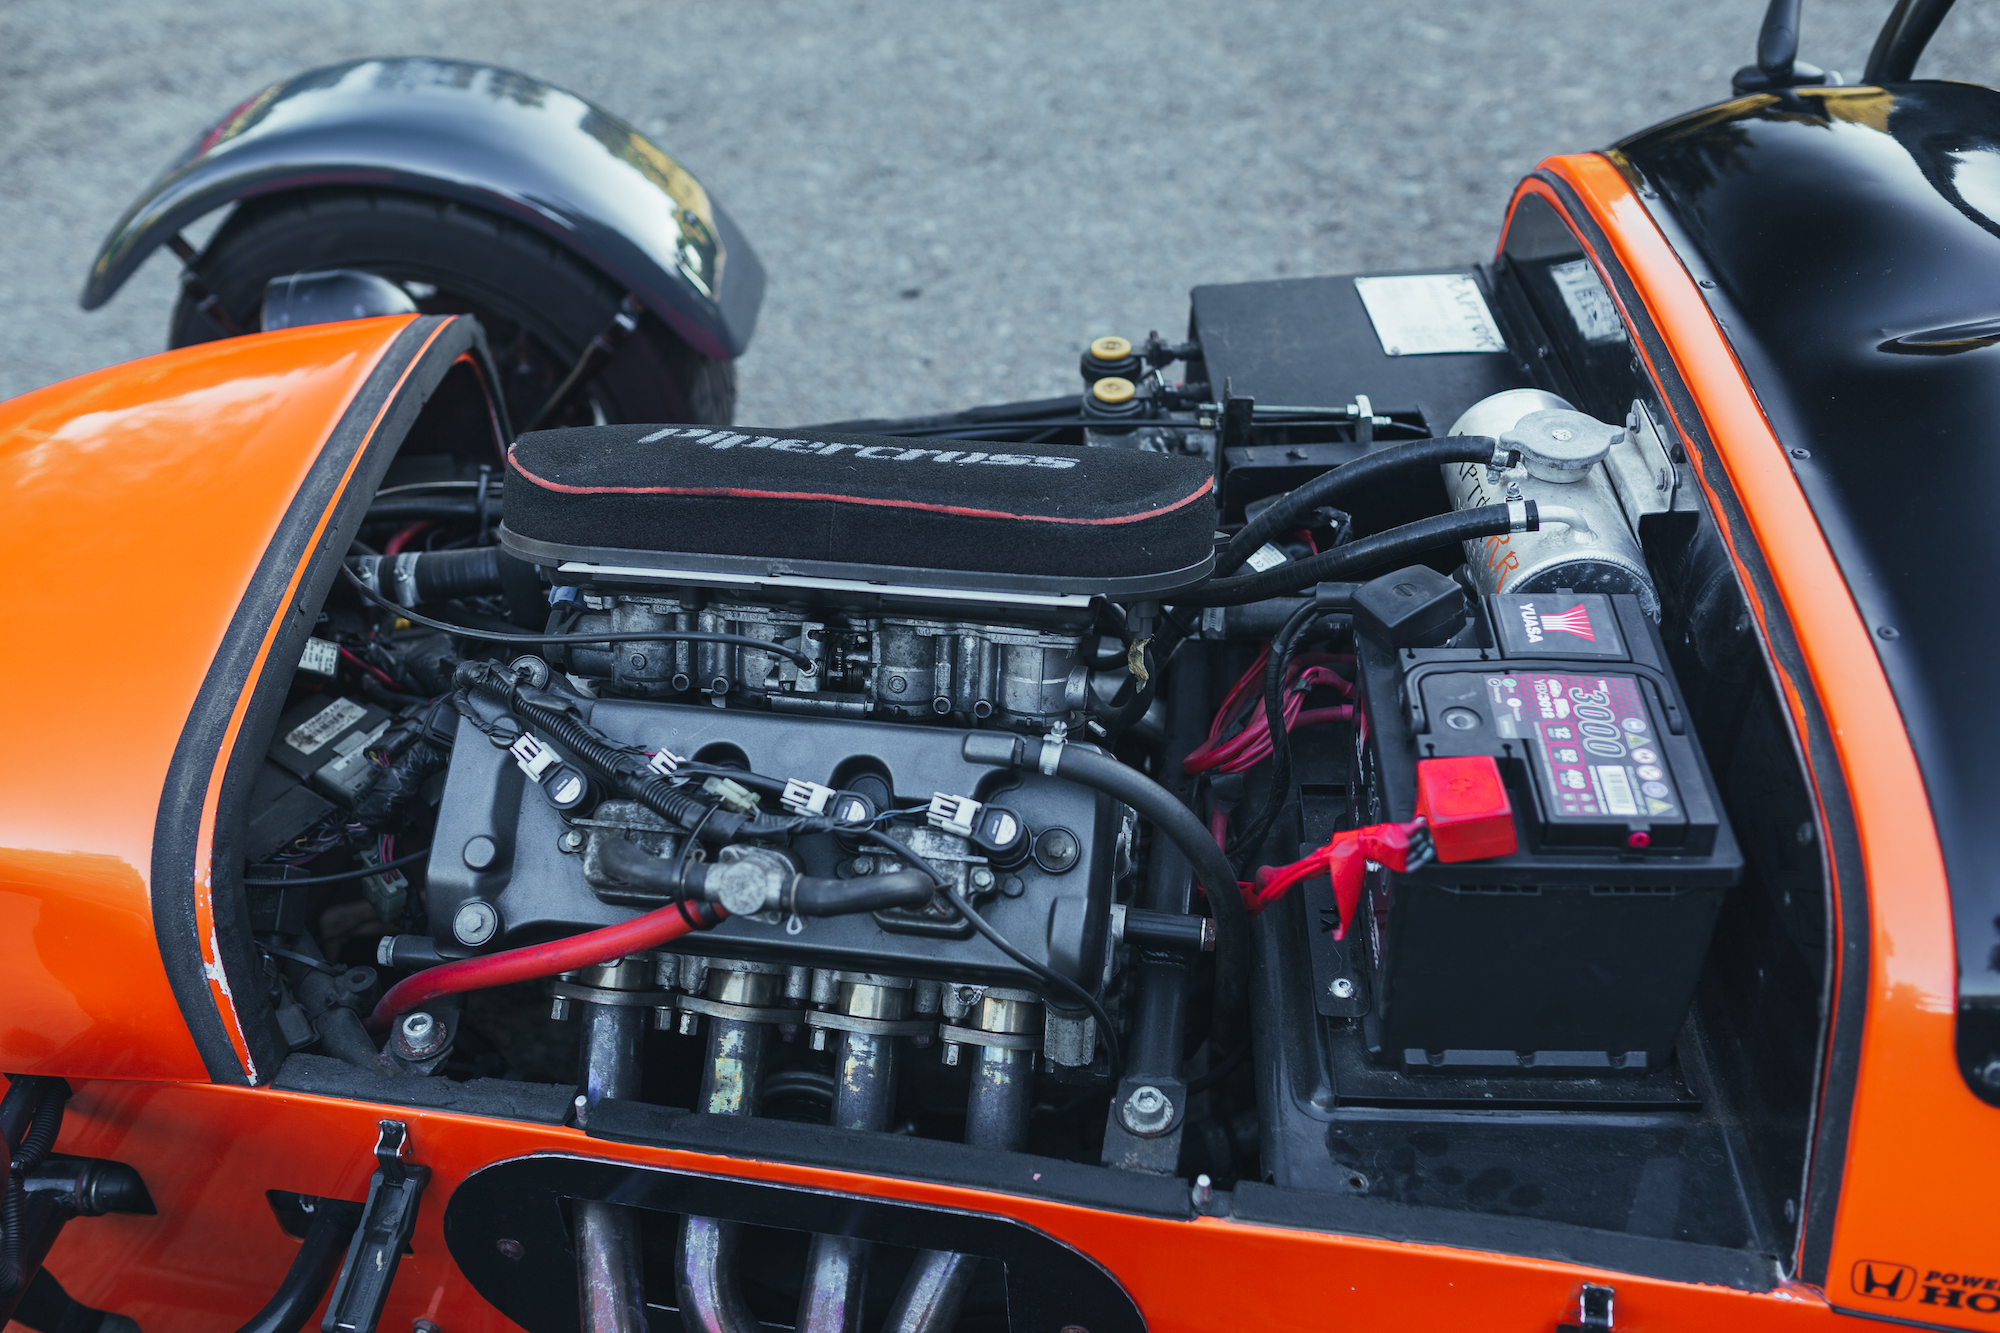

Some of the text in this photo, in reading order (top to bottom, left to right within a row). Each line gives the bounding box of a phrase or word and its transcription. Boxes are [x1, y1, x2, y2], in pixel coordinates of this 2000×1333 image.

[1486, 534, 1519, 594] RR
[1519, 602, 1544, 644] YUASA
[1554, 727, 1572, 739] 12
[1568, 687, 1627, 758] 3000
[1924, 1270, 2000, 1293] POWE
